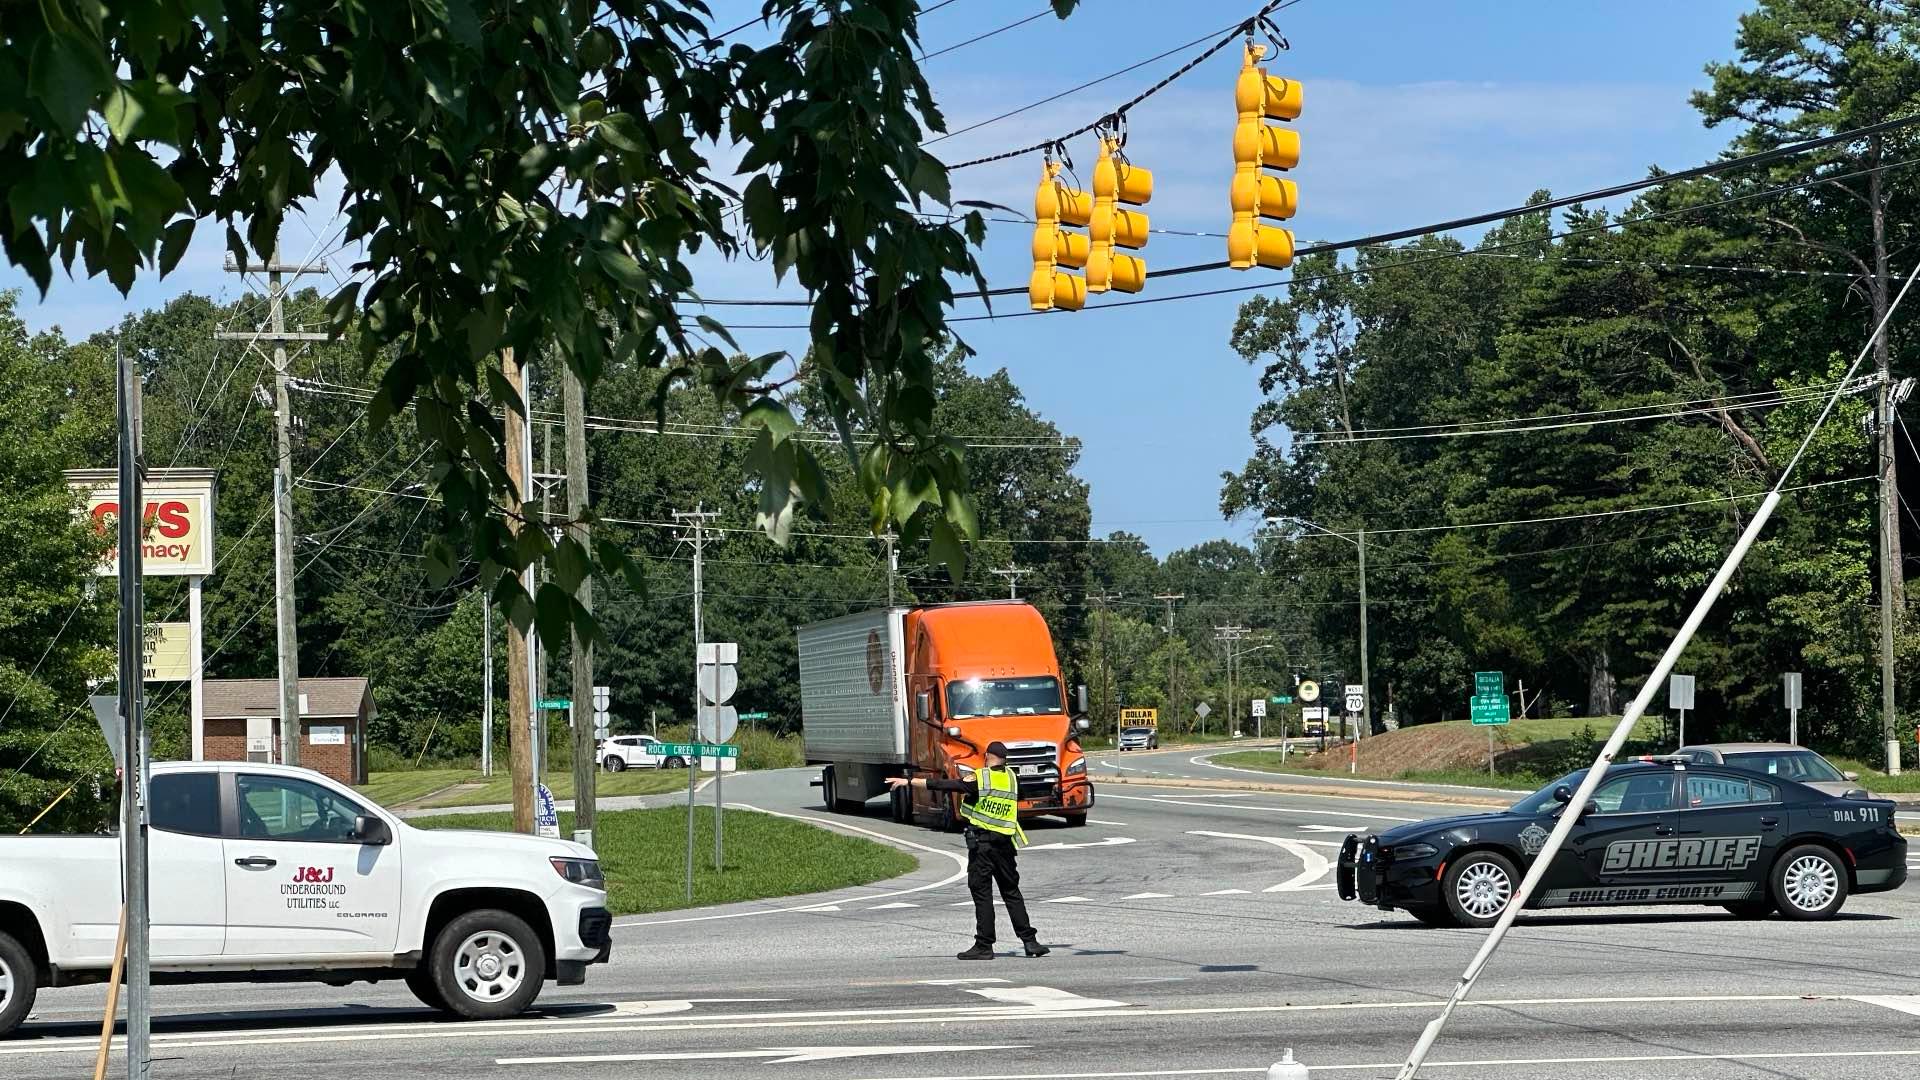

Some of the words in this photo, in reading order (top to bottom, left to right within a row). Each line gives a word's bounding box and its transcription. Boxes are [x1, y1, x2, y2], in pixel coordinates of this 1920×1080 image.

[1348, 698, 1362, 709] 70
[1125, 710, 1153, 718] DOLLAR
[1123, 718, 1155, 726] GENERAL
[648, 744, 667, 755] ROCK
[673, 745, 695, 756] CREEK
[701, 747, 721, 757] DAIRY
[727, 748, 738, 757] RD
[980, 798, 1012, 817] SHERIFF
[1833, 810, 1857, 822] DIAL
[1859, 807, 1879, 822] 911
[1604, 837, 1758, 870] SHERIFF
[292, 866, 334, 883] J&J
[280, 884, 346, 895] UNDERGROUND
[1567, 887, 1650, 903] GUILFORD
[1655, 885, 1725, 900] COUNTY
[287, 898, 327, 909] UTILITIES
[329, 900, 340, 909] LLC
